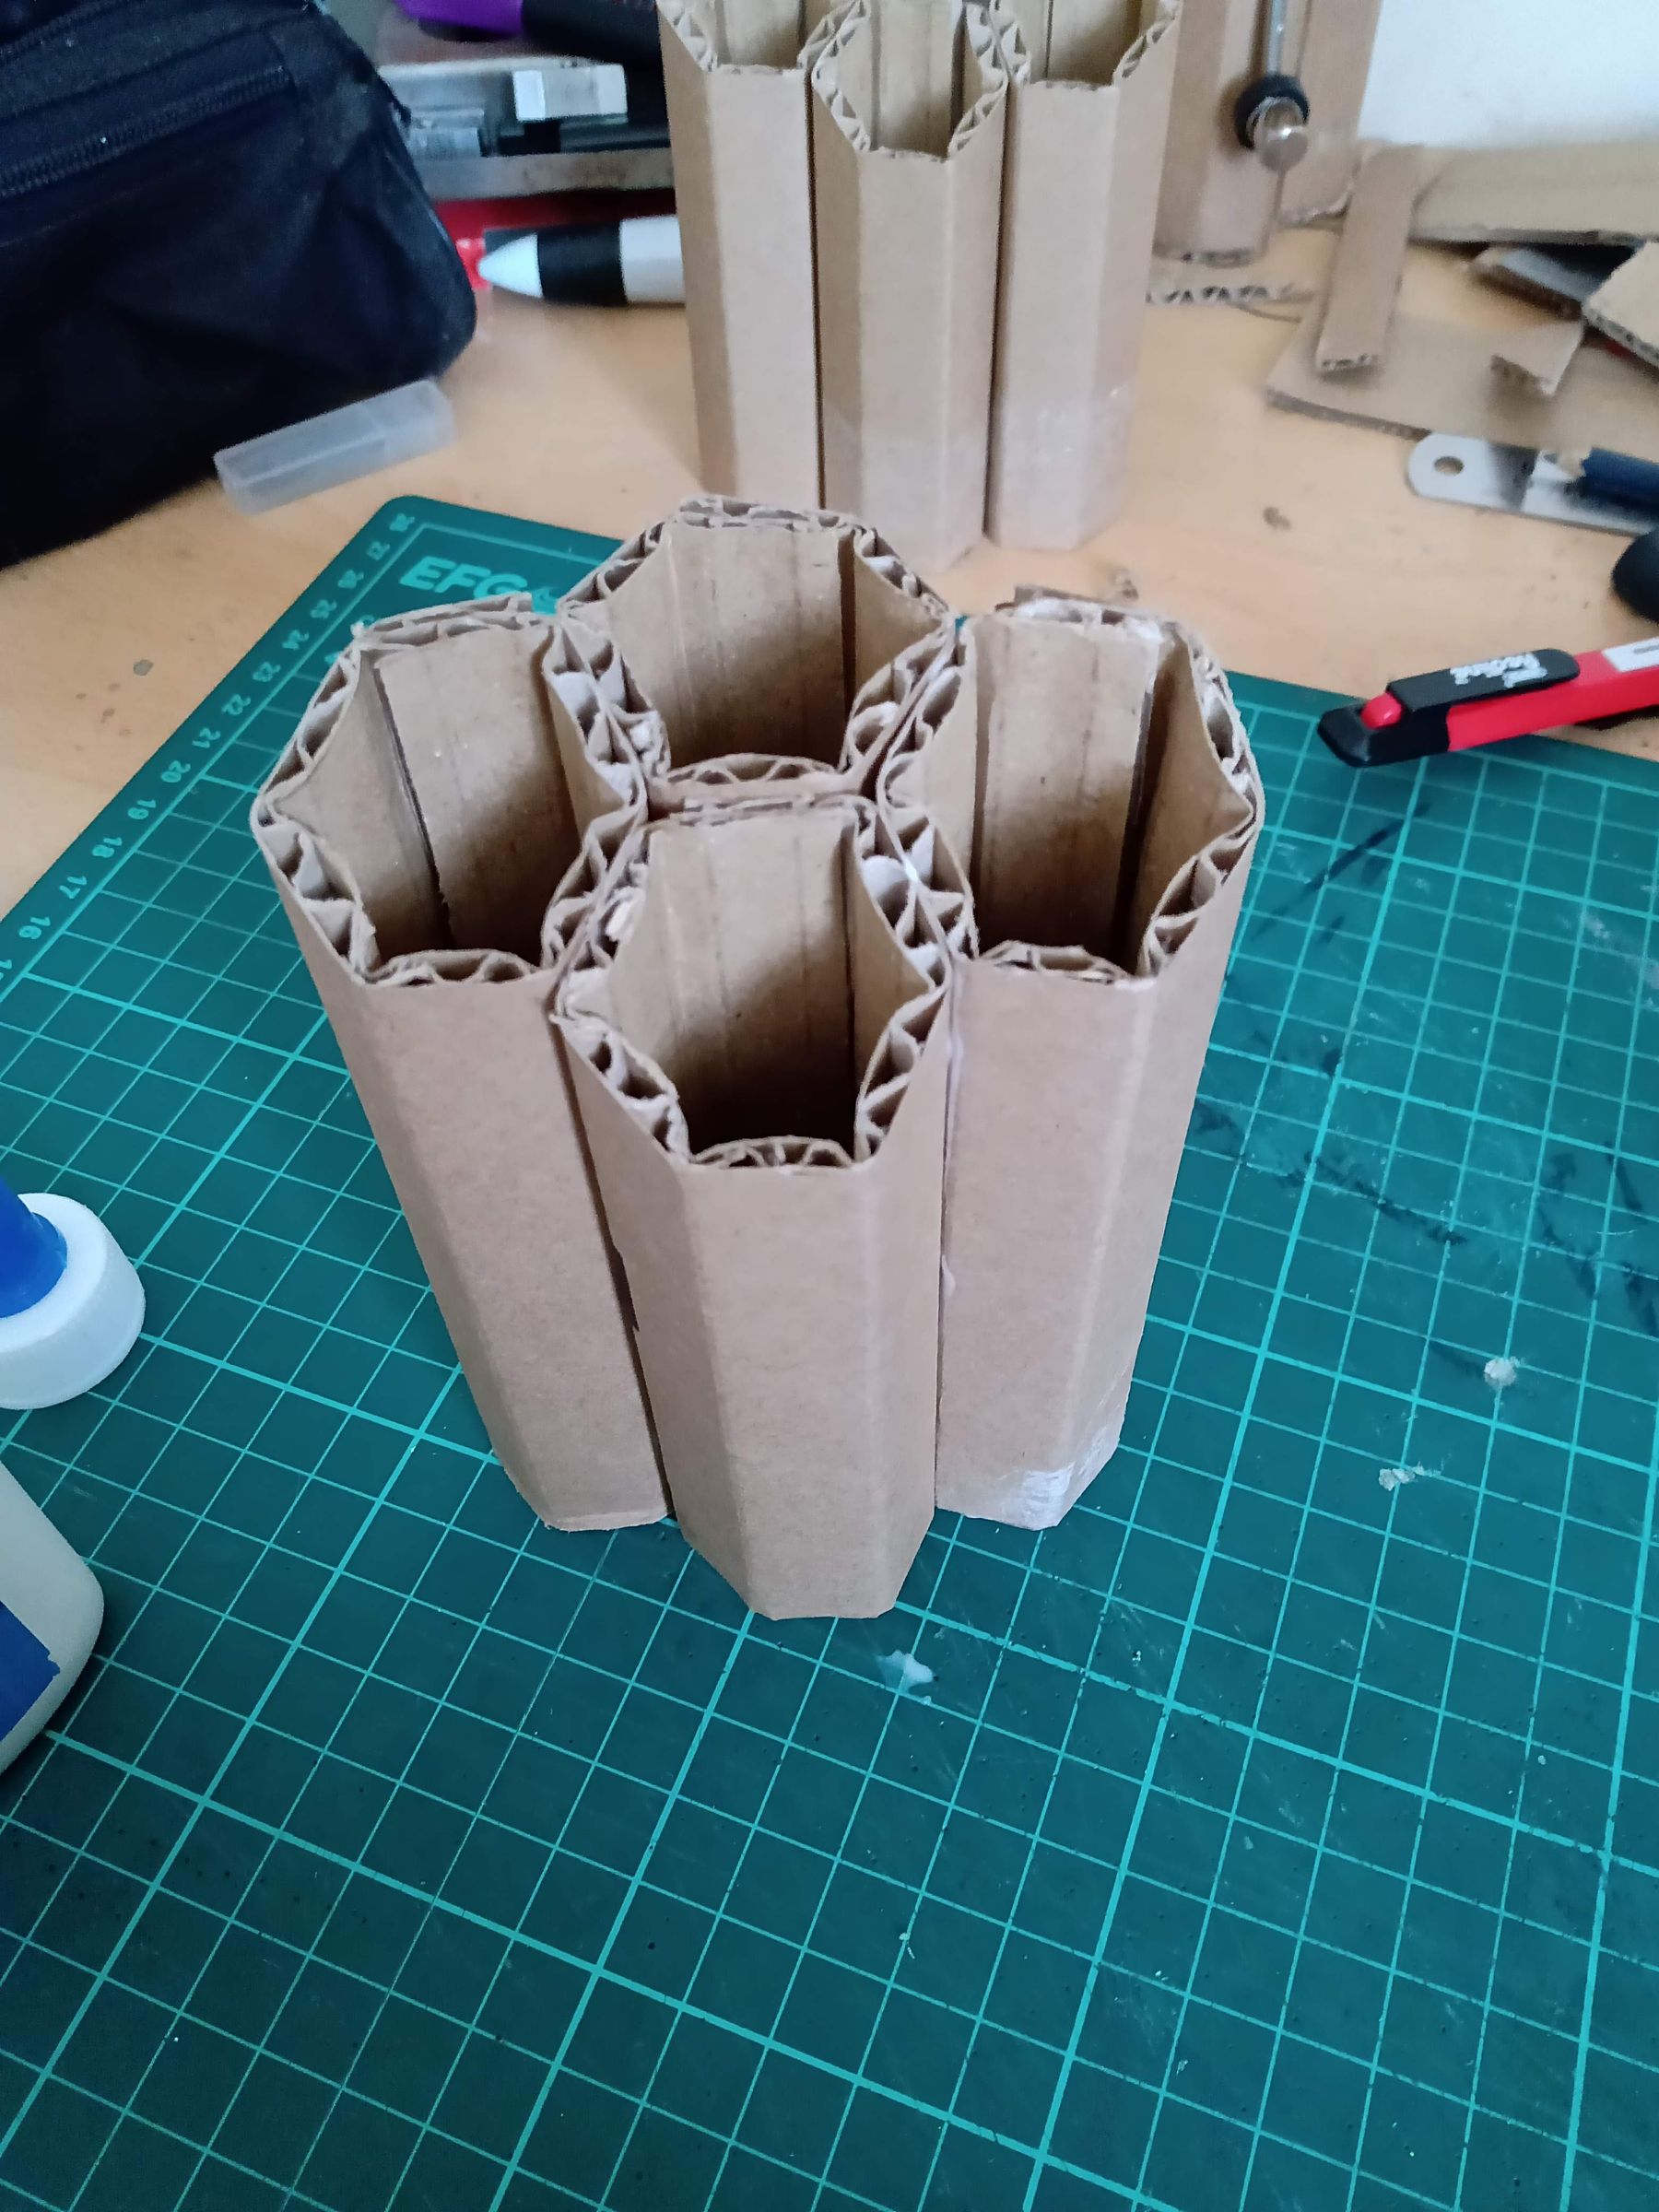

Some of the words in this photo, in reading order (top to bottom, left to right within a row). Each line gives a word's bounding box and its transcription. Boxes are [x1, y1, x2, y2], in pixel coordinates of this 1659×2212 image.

[253, 662, 281, 682] 23
[221, 694, 251, 715] 22
[192, 728, 220, 748] 21
[161, 760, 191, 782] 20
[127, 800, 156, 819] 19
[92, 837, 123, 858] 18
[59, 876, 87, 899] 17
[18, 917, 51, 939] 16
